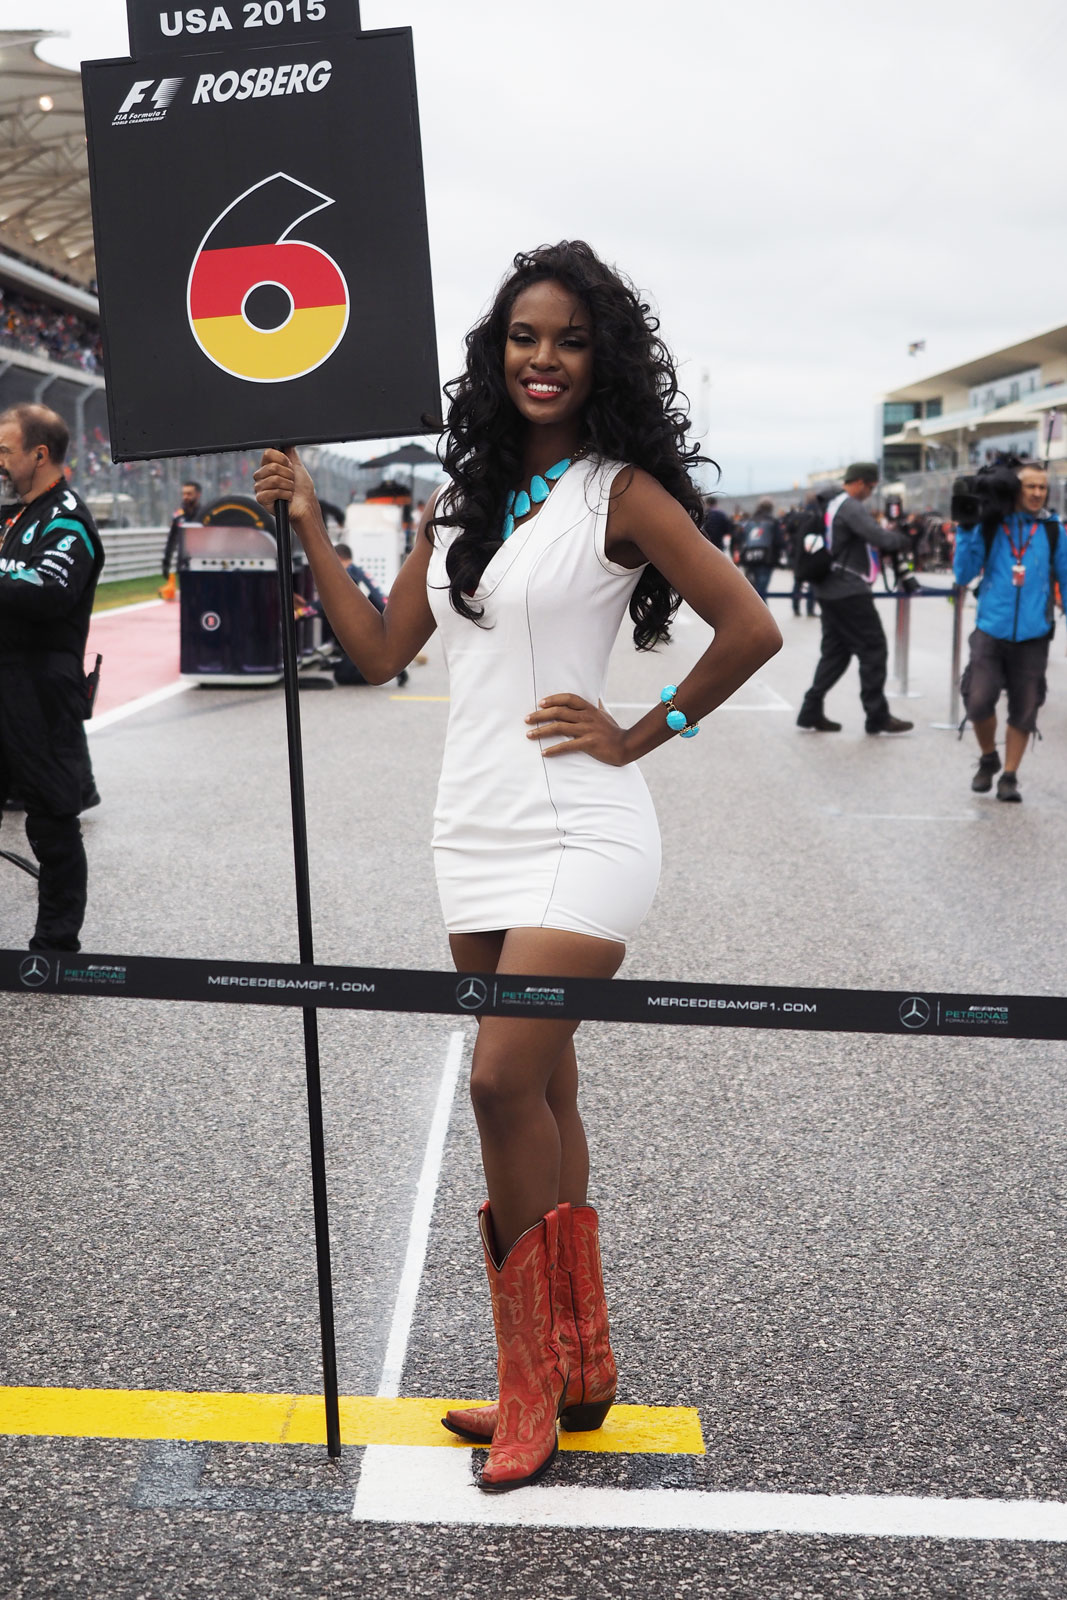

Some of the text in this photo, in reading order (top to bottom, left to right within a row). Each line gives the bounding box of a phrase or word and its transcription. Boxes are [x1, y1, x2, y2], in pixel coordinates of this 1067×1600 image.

[159, 0, 327, 37] USA 2015
[191, 60, 333, 105] ROSBERG
[113, 113, 128, 122] FIA
[128, 110, 161, 120] Formula
[186, 171, 351, 383] 6
[64, 969, 126, 979] PETRONAS
[207, 975, 376, 993] MERCEDESAMGF1.COM
[502, 991, 565, 1002] PETRONAS
[647, 996, 817, 1013] MERCEDESAMGF1.COM
[945, 1010, 1009, 1020] PETRONAS
